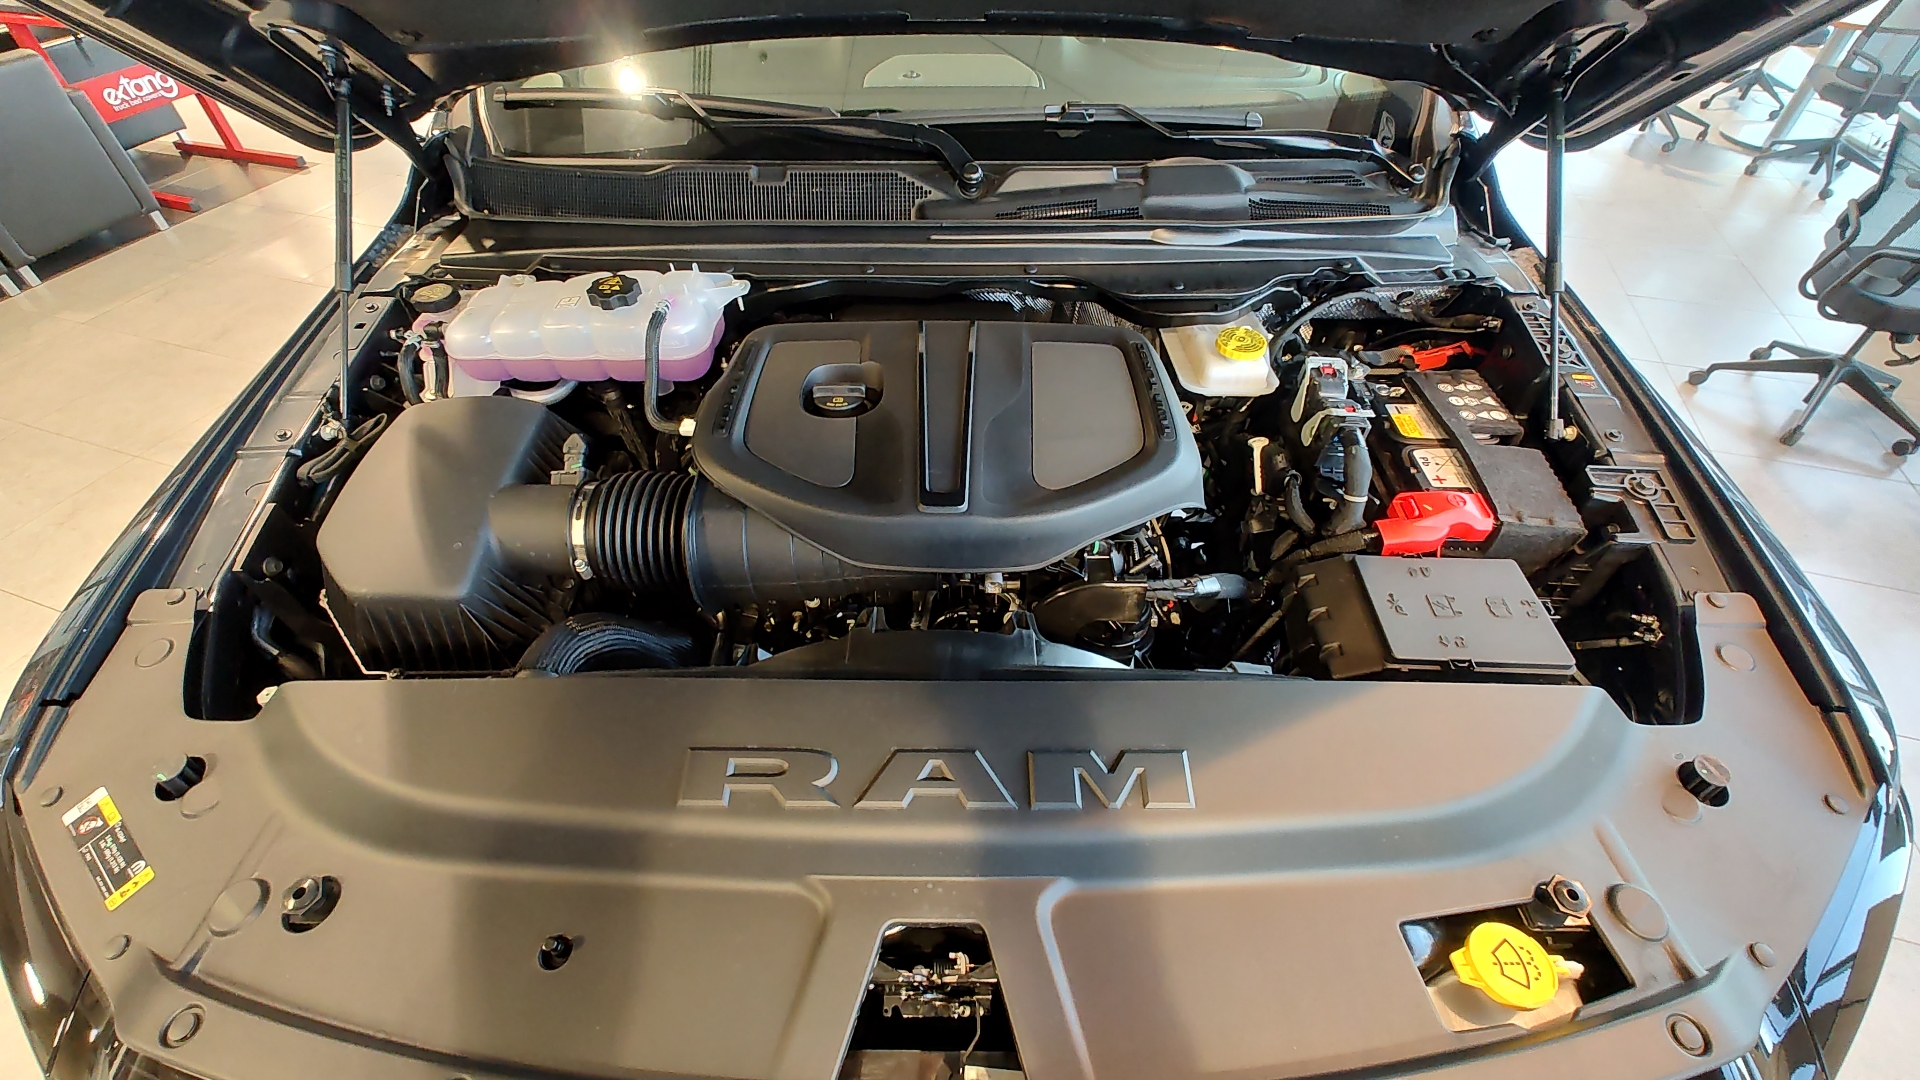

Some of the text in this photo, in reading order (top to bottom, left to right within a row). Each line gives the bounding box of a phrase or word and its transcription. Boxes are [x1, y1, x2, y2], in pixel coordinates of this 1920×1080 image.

[103, 72, 179, 105] extang
[129, 97, 142, 107] bed
[1419, 456, 1431, 466] Pb
[677, 746, 1196, 811] RAM
